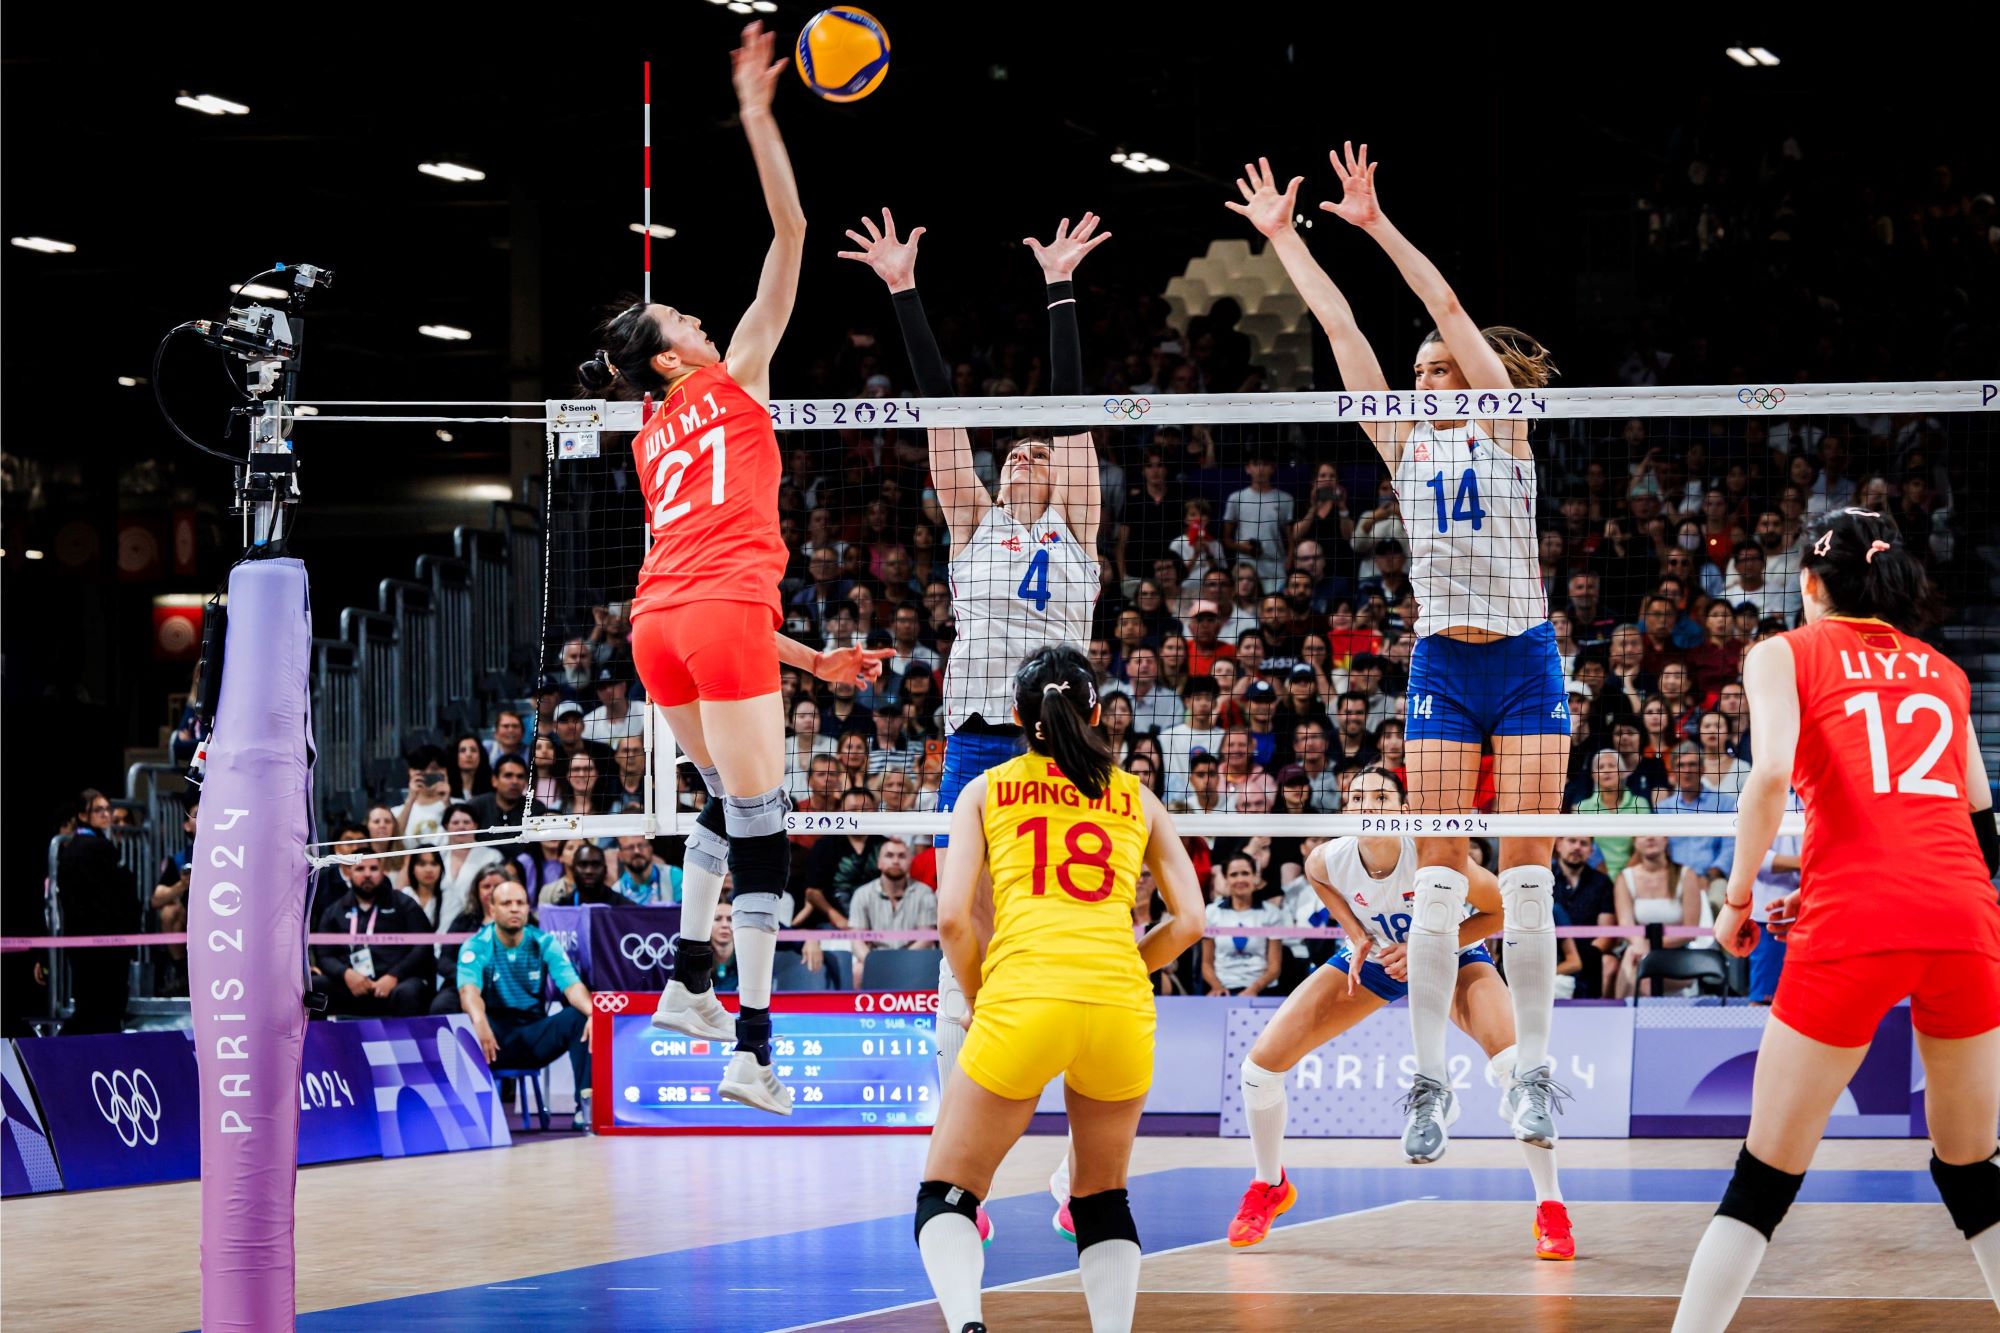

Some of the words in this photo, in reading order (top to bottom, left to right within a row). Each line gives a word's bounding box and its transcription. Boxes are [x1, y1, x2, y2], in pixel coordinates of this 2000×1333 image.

[568, 403, 597, 412] Senoh
[832, 401, 920, 424] 2024
[1455, 392, 1546, 415] 2024
[645, 422, 676, 463] WU
[679, 392, 727, 435] M.J.
[653, 425, 726, 529] 21
[1426, 468, 1486, 533] 14
[1017, 549, 1052, 611] 4
[1839, 650, 1872, 679] LI
[1874, 651, 1940, 680] Y.Y.
[1412, 693, 1433, 720] 14
[1843, 691, 1959, 799] 12
[997, 781, 1080, 808] WANG
[805, 816, 858, 830] 2024
[1432, 818, 1488, 831] 2024
[1016, 816, 1116, 903] 18
[208, 808, 250, 953] 2024
[1371, 913, 1413, 944] 18
[879, 993, 940, 1012] OMEG
[860, 1018, 876, 1029] TO
[884, 1018, 906, 1029] SUB
[651, 1040, 687, 1057] CHN
[775, 1039, 796, 1056] 25
[803, 1039, 823, 1056] 26
[862, 1039, 874, 1055] 0
[890, 1039, 899, 1055] 1
[918, 1039, 928, 1055] 1
[658, 1086, 688, 1102] SRB
[803, 1086, 824, 1102] 26
[862, 1086, 875, 1101] 0
[890, 1086, 902, 1101] 4
[918, 1085, 929, 1101] 2
[861, 1112, 877, 1123] TO
